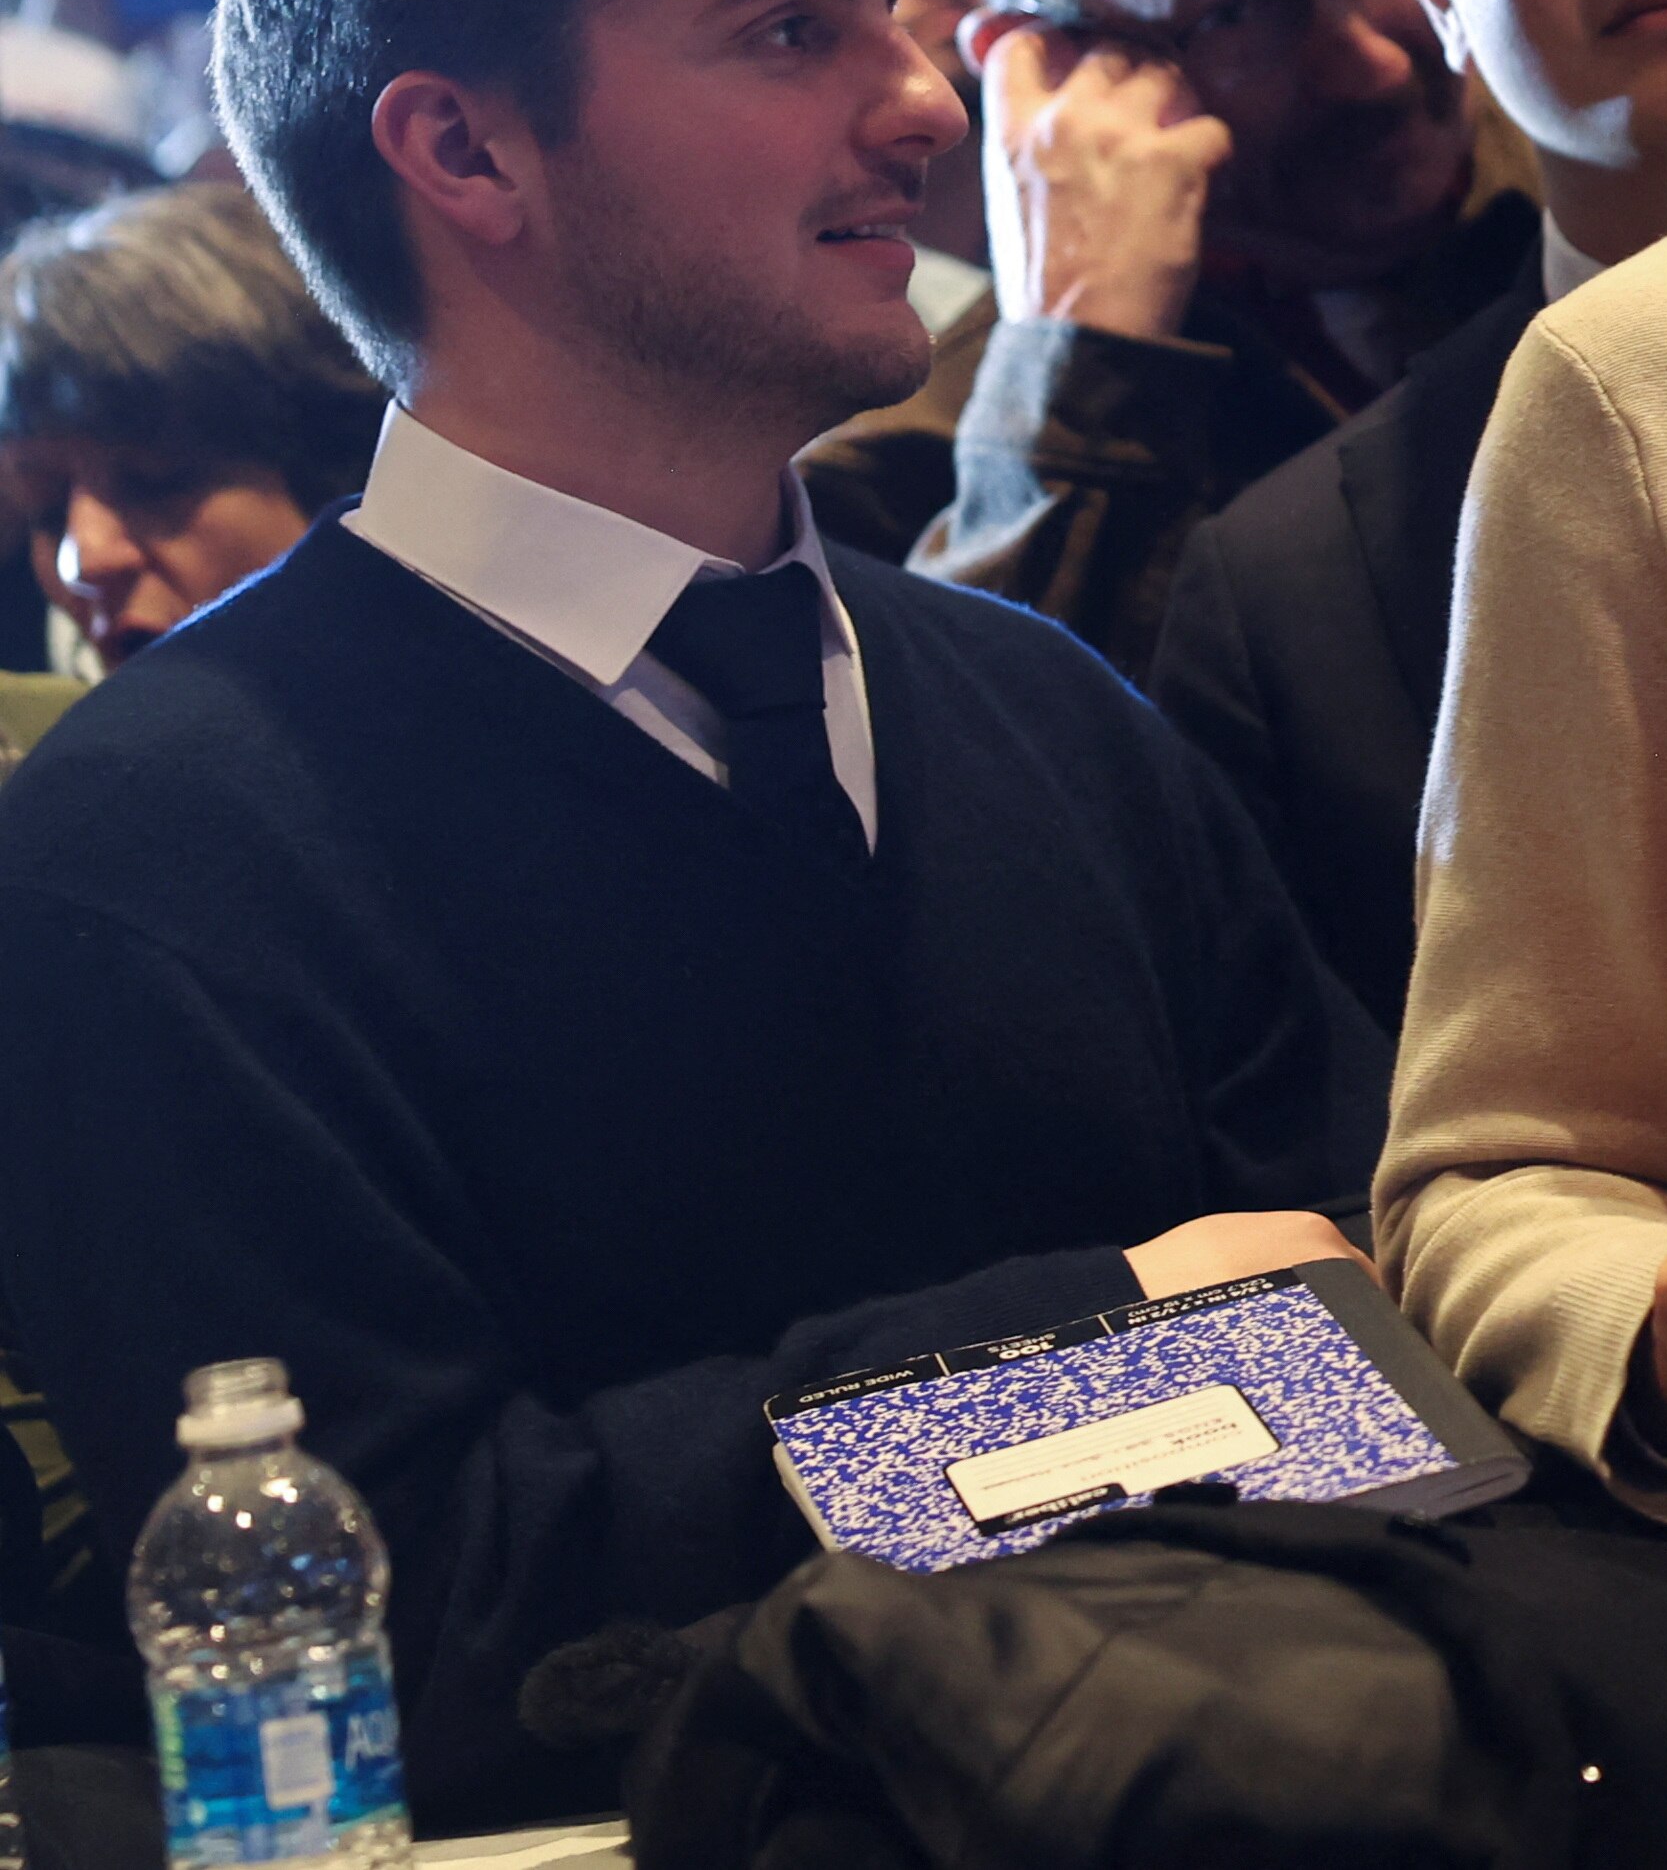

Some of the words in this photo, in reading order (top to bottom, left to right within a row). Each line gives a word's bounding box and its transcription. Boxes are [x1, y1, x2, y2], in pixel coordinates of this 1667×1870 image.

[986, 1332, 1057, 1354] SHEETS
[998, 1342, 1055, 1361] 100
[863, 1368, 915, 1388] WIDE
[797, 1379, 862, 1405] RULED
